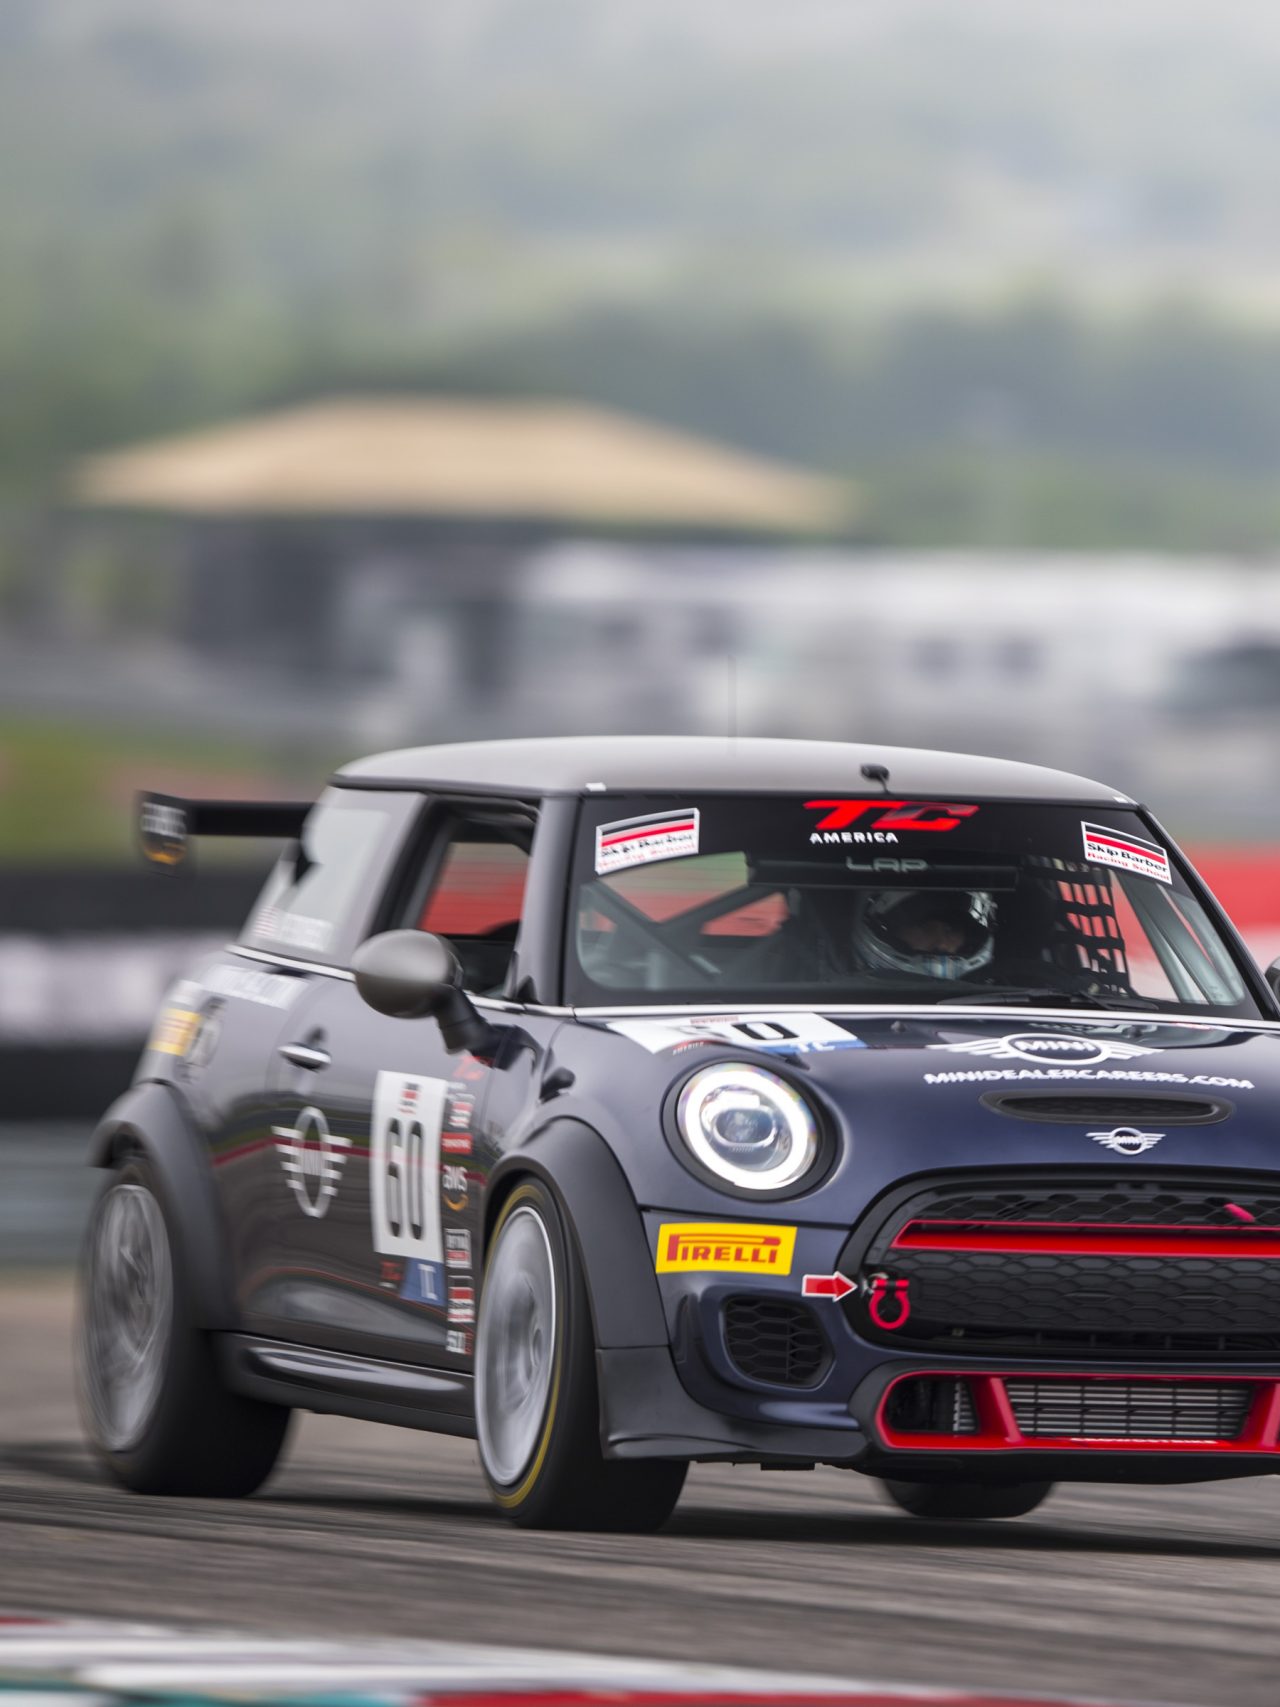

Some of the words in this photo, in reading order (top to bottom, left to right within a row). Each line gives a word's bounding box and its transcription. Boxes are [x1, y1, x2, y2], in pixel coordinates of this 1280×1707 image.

[803, 800, 980, 831] TC
[808, 832, 899, 844] AMERICA
[846, 856, 929, 873] LAP
[1087, 843, 1119, 857] Skip
[1120, 851, 1168, 873] Barber
[1132, 862, 1170, 881] School
[1014, 1040, 1098, 1052] MINI
[923, 1069, 1256, 1090] MINIDEALERCAREERS.COM
[385, 1116, 425, 1242] 60
[666, 1233, 781, 1265] PIRELLI
